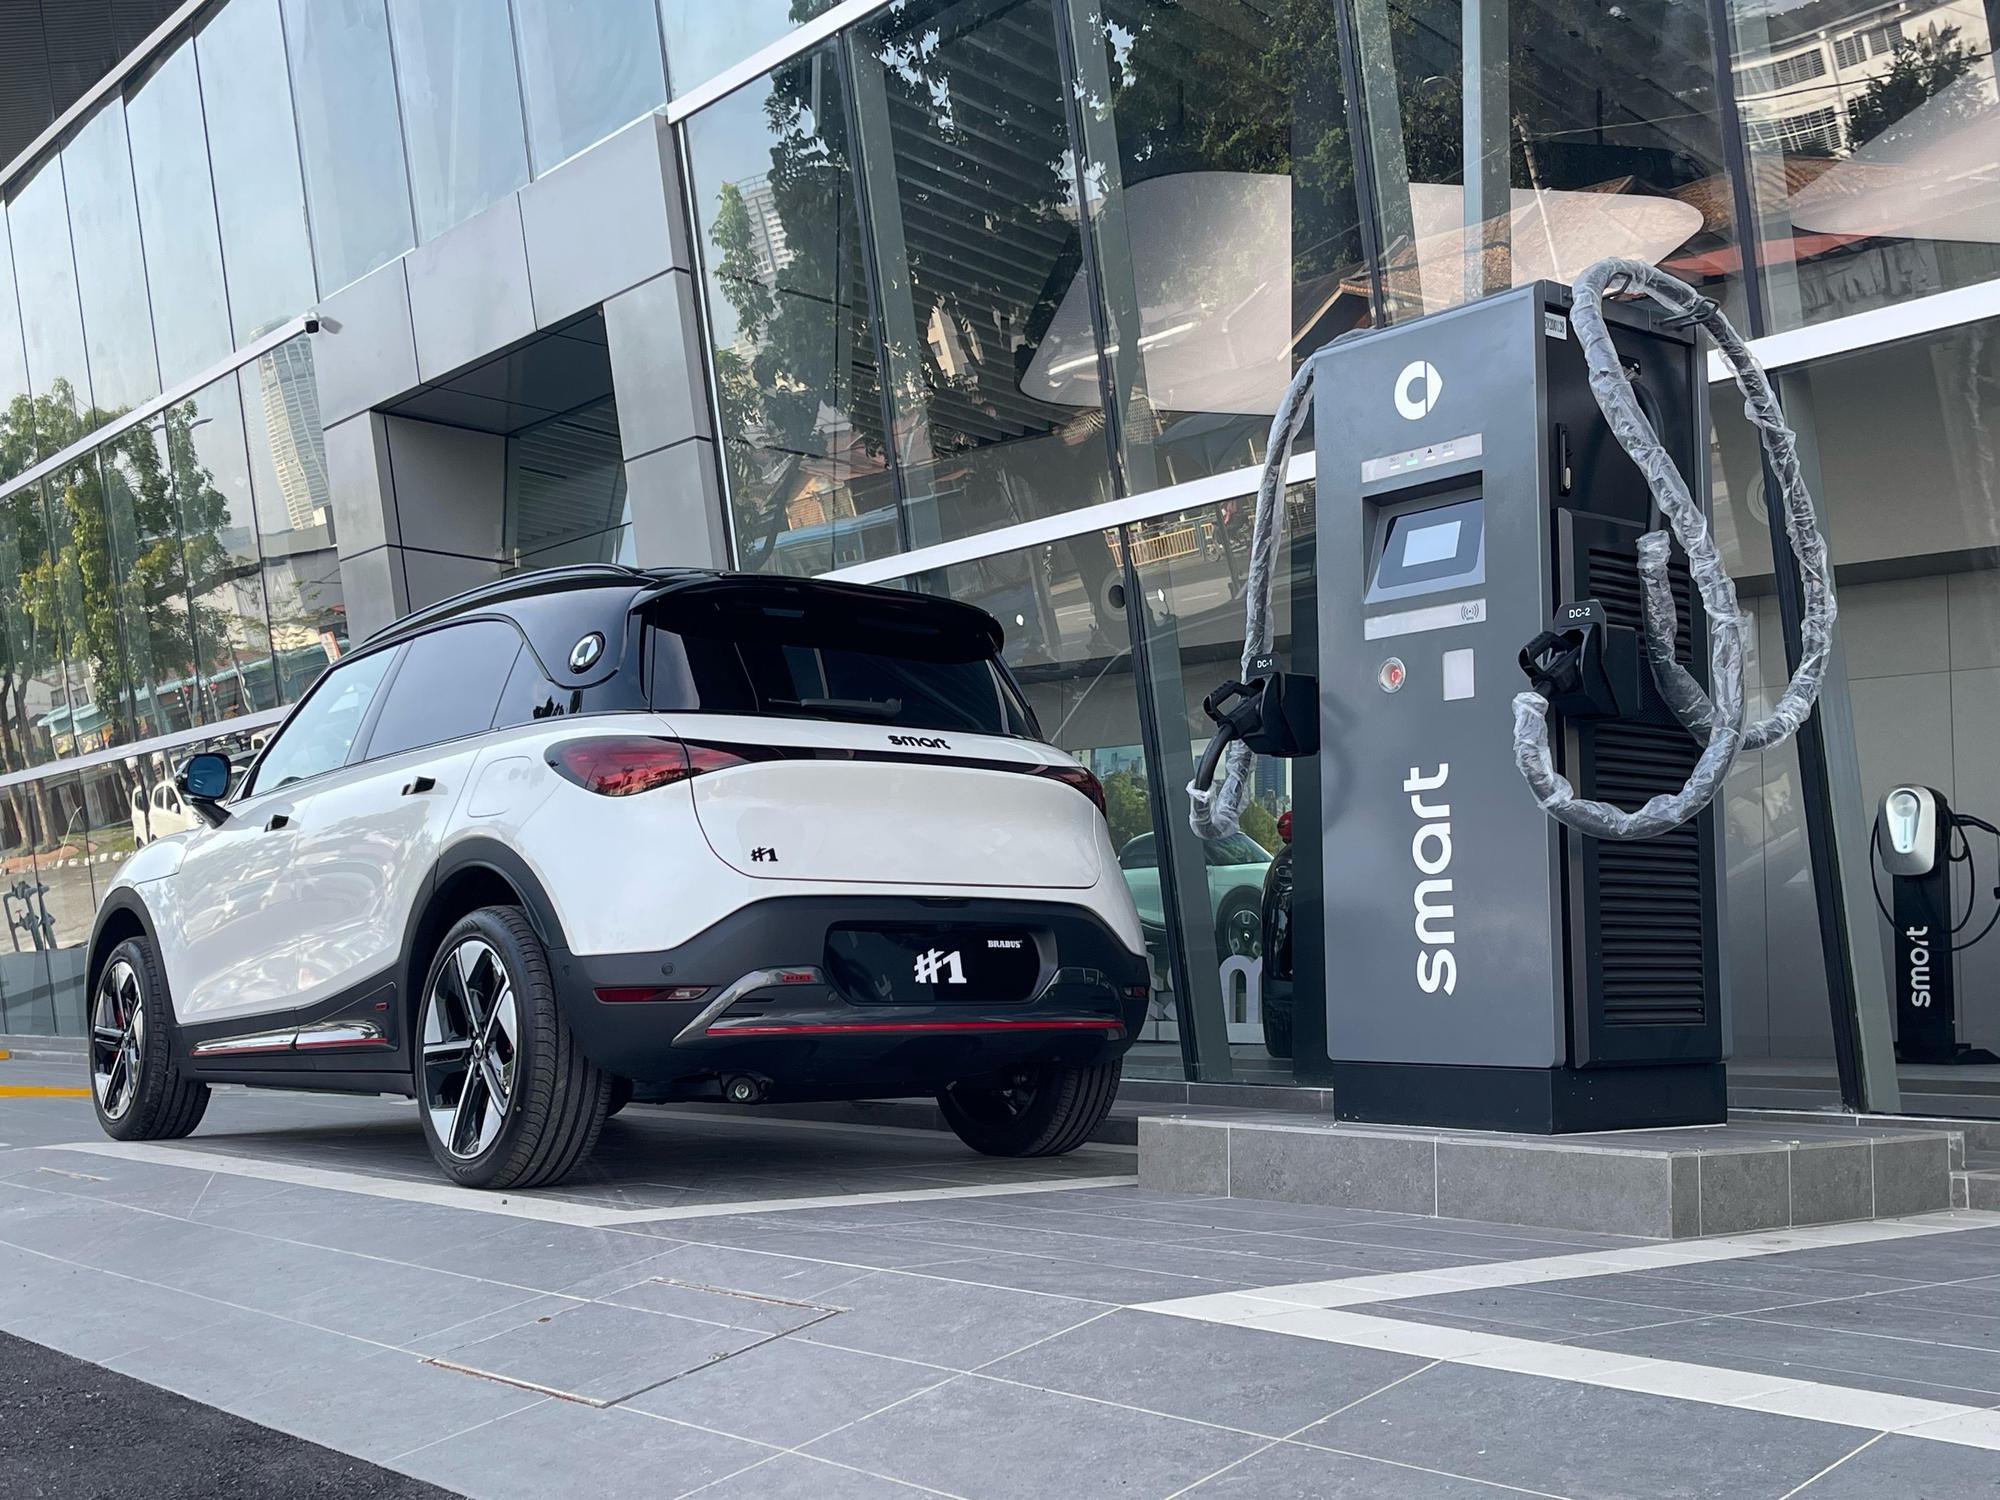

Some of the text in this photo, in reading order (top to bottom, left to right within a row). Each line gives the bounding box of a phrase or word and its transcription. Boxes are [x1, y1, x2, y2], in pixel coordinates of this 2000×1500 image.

[1569, 607, 1591, 619] DC-2
[1257, 659, 1273, 669] DC-1
[888, 735, 951, 750] smart
[751, 846, 778, 862] #1
[1403, 763, 1457, 997] smart
[914, 948, 967, 984] #1
